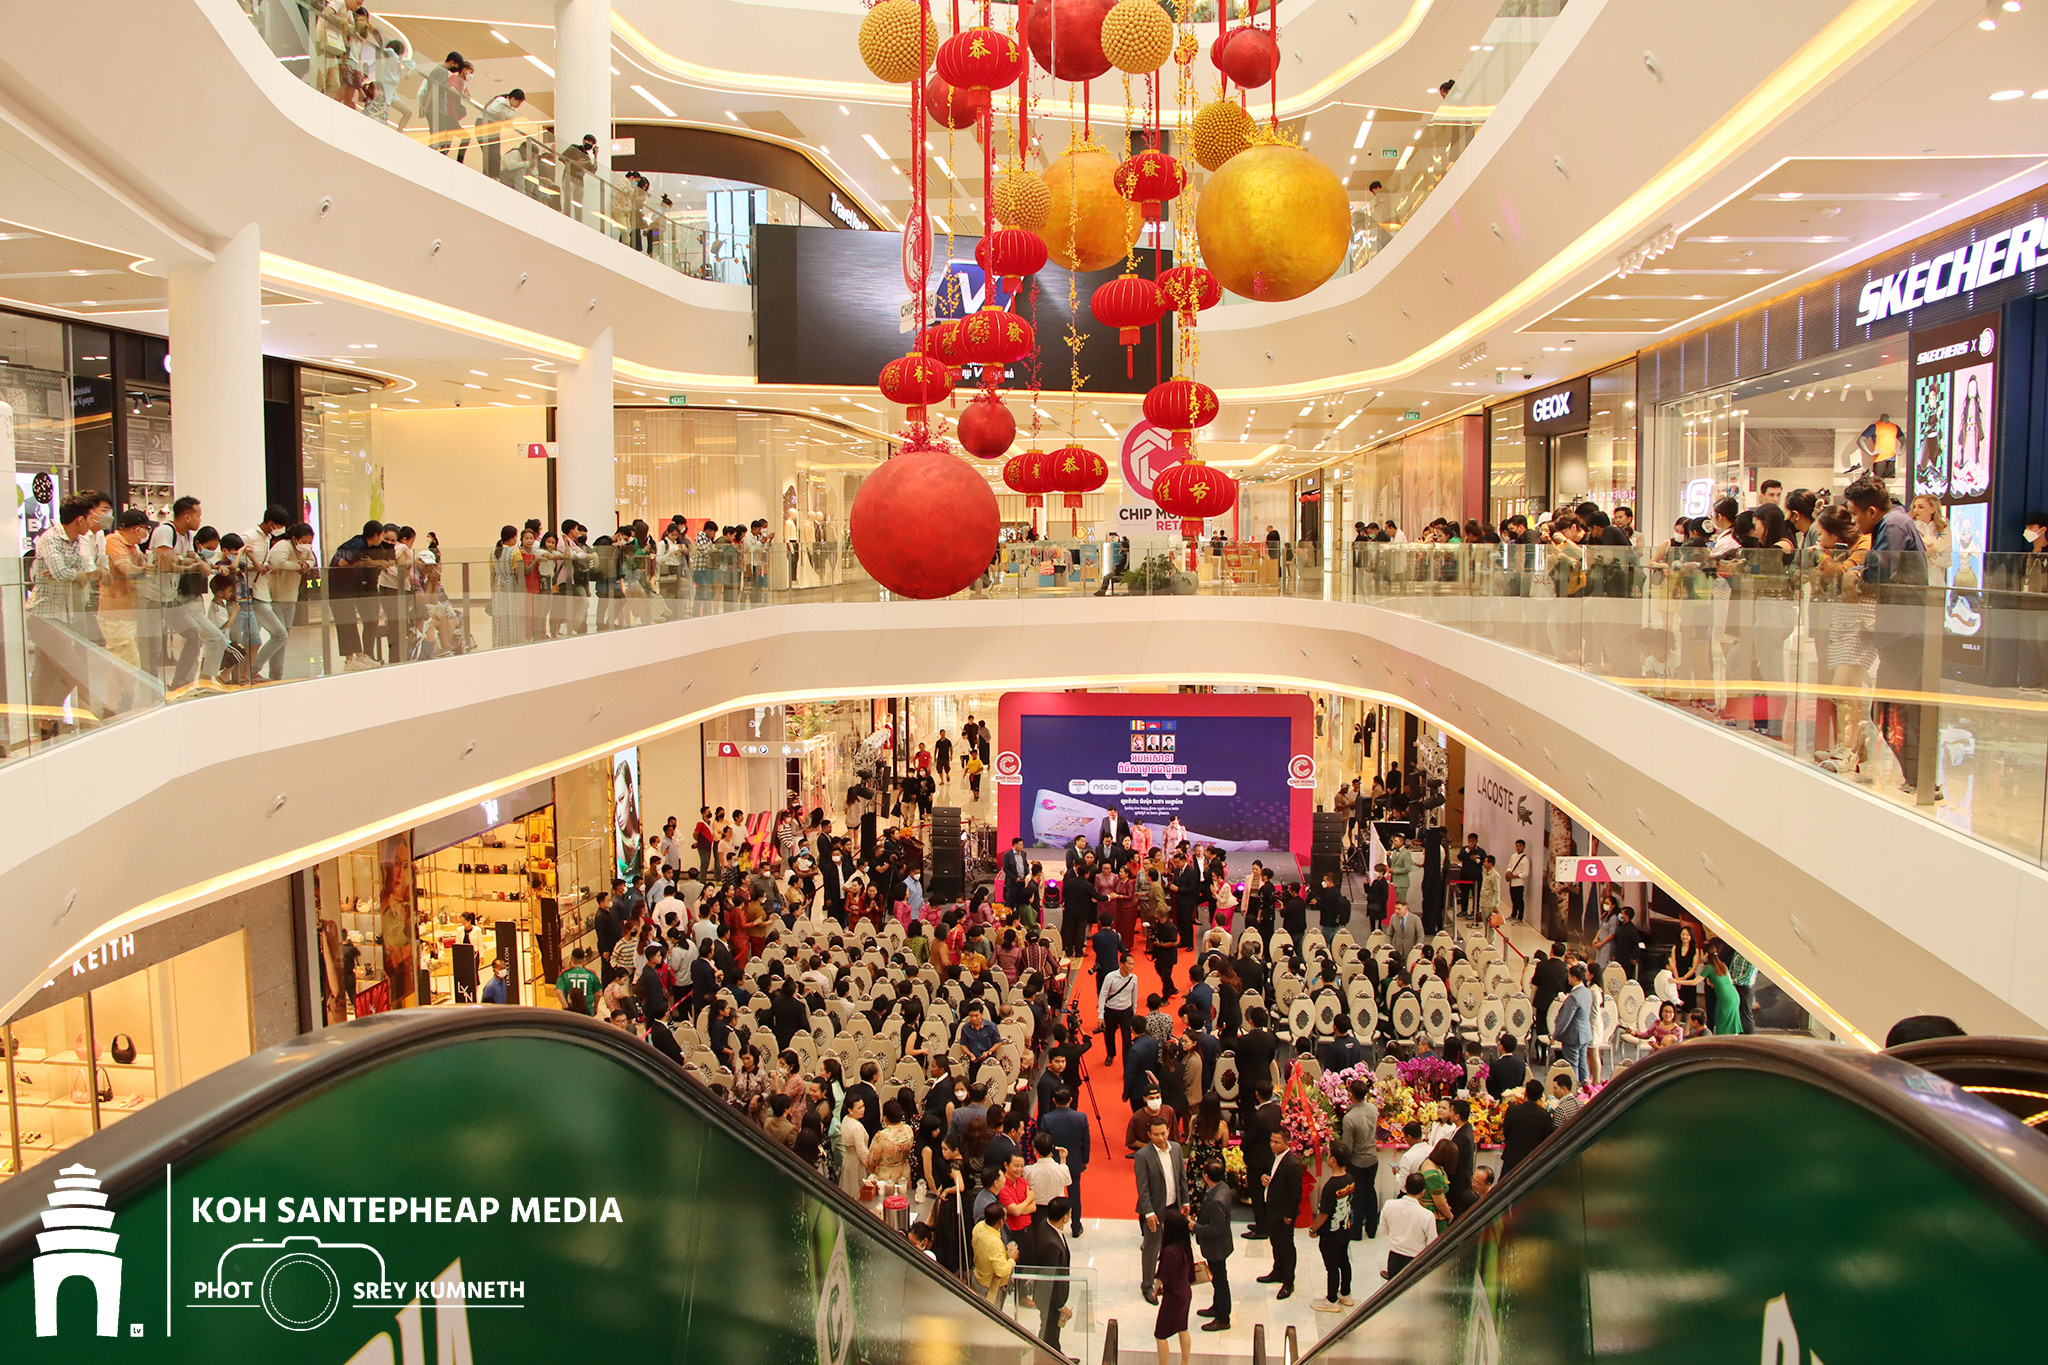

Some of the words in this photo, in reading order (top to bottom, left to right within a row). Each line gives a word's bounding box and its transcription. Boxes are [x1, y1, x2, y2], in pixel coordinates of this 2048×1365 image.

[1915, 340, 1970, 366] SKECHERS
[1532, 391, 1571, 422] GEOX
[533, 446, 539, 455] 1
[1119, 509, 1152, 520] CHIP
[723, 745, 732, 754] G
[1477, 773, 1513, 814] LACOSTE
[1585, 864, 1598, 876] G
[72, 933, 135, 976] KEITH
